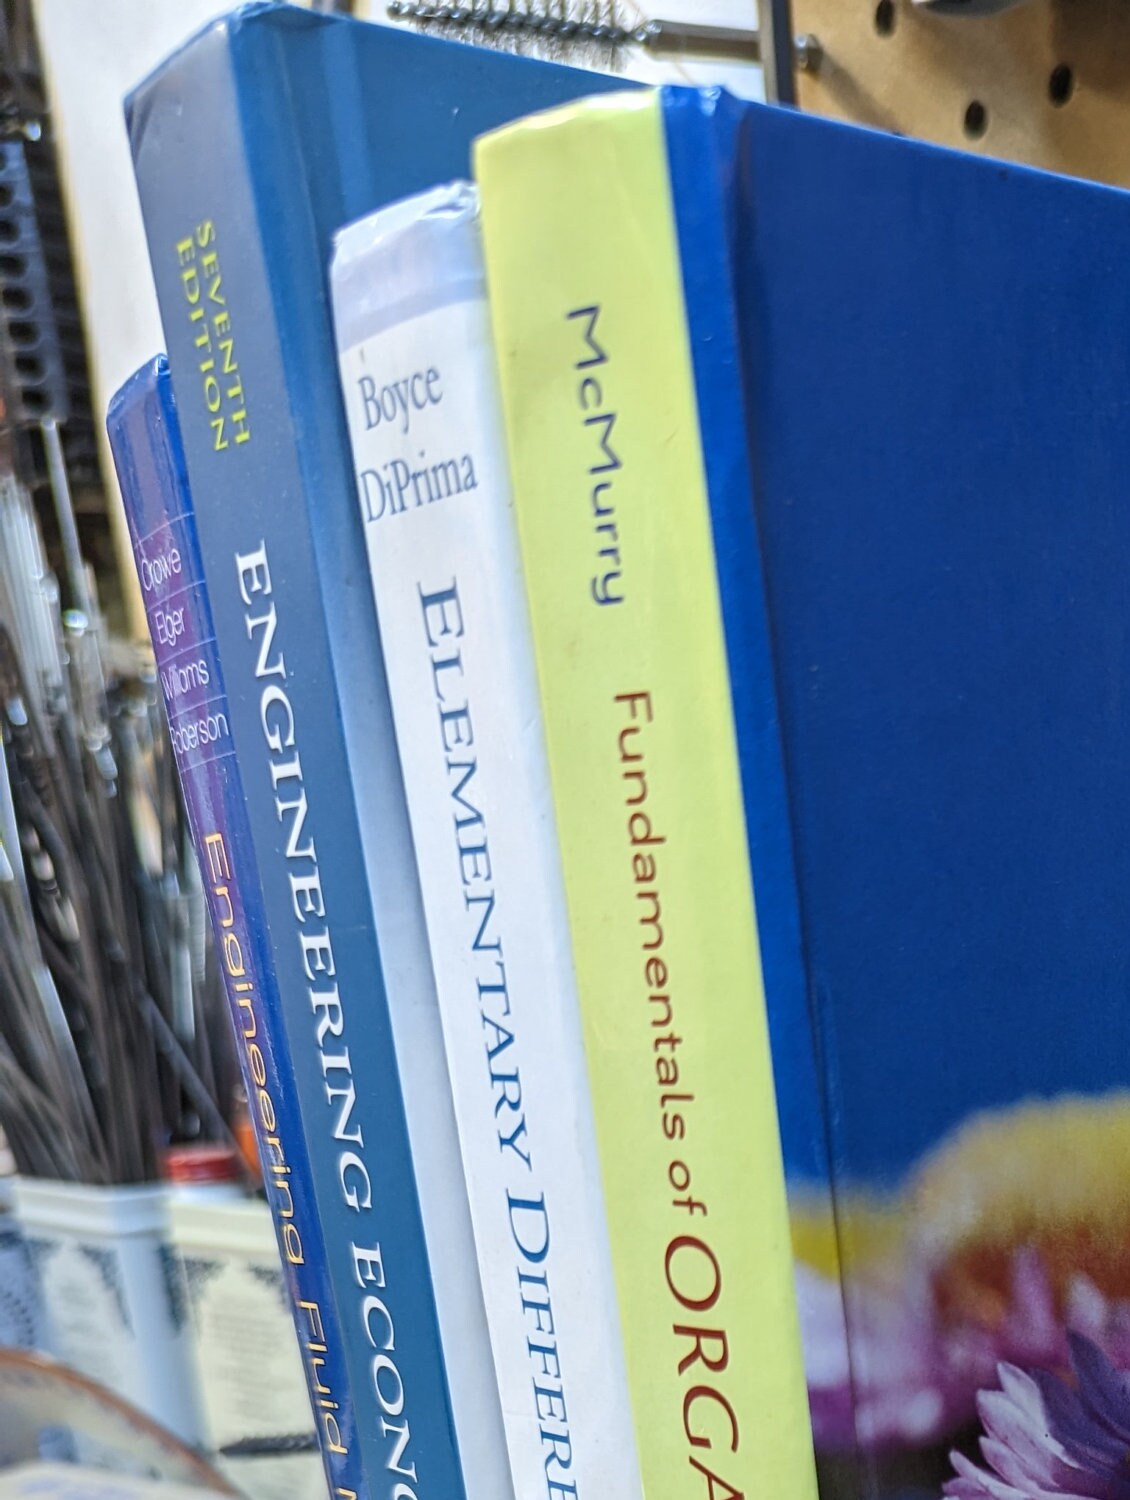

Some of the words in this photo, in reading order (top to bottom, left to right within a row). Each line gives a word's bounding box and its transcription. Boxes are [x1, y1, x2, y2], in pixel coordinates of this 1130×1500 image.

[176, 237, 229, 451] EDITION
[196, 219, 251, 444] SEVENTH
[358, 368, 443, 435] Boyce
[360, 450, 479, 523] DiPrima
[566, 304, 625, 606] McMurry
[141, 548, 182, 592] Crowe
[154, 607, 185, 647] Elger
[234, 539, 373, 1213] ENGINEERING
[417, 576, 532, 1172] ELEMENTARY
[614, 690, 695, 1142] Fundamentals
[668, 1160, 708, 1217] of
[204, 832, 305, 1266] Engineering
[299, 1300, 349, 1455] Fluid
